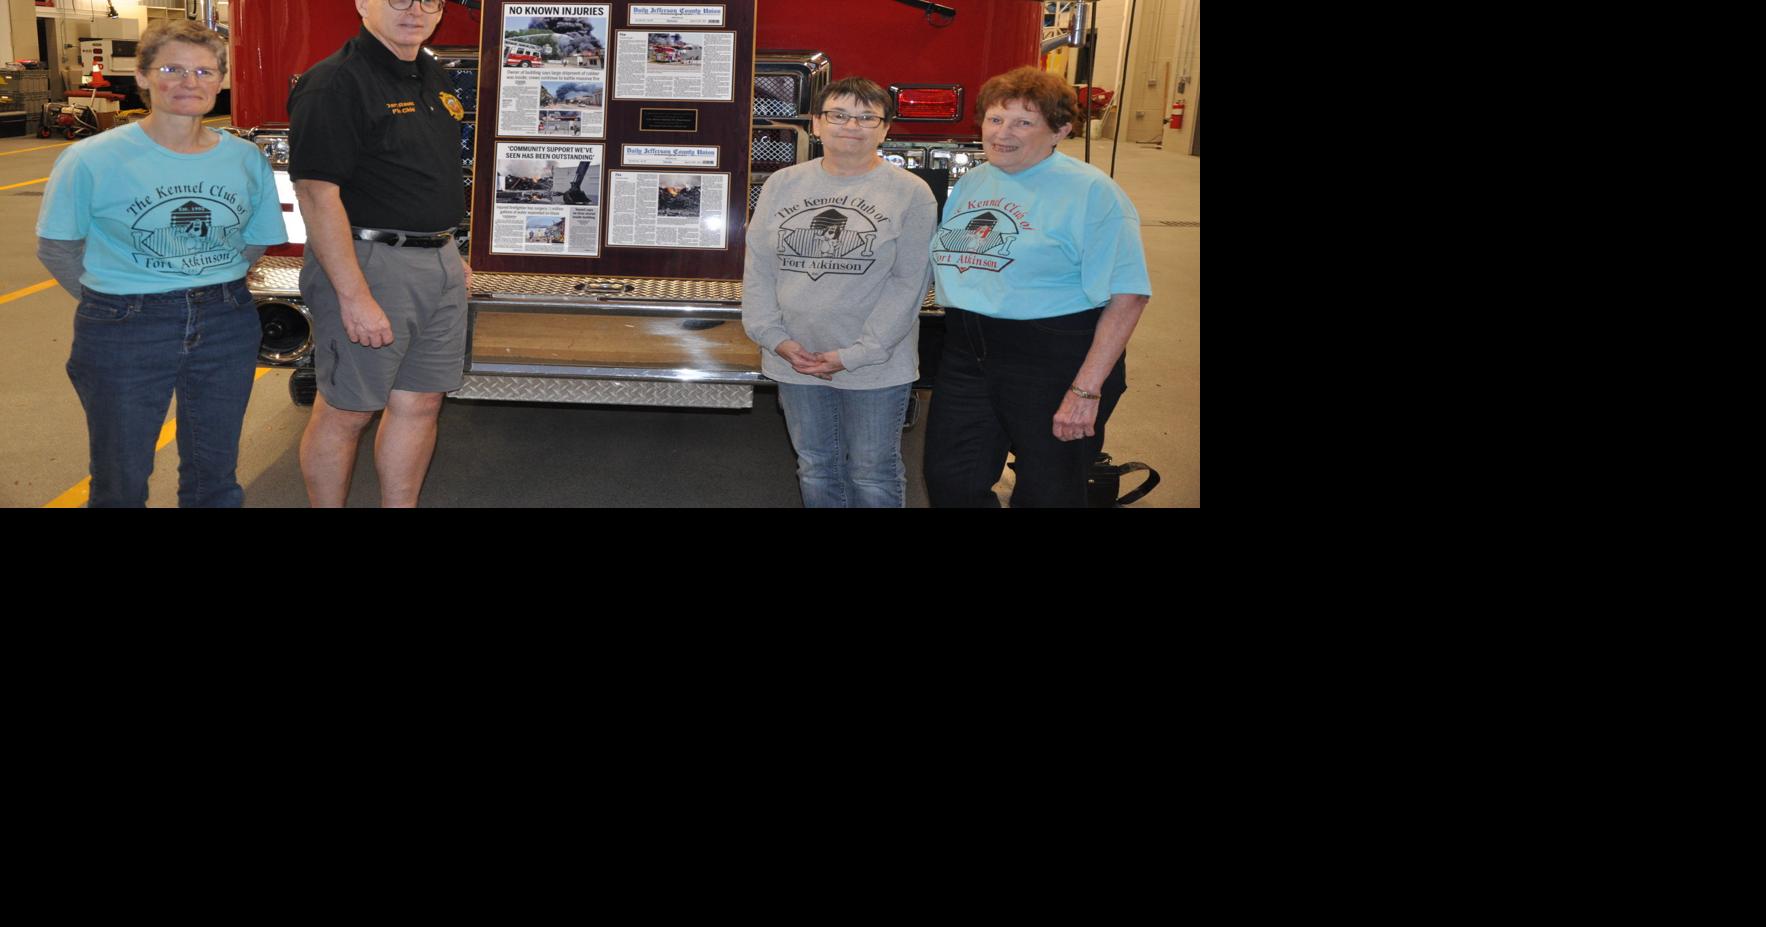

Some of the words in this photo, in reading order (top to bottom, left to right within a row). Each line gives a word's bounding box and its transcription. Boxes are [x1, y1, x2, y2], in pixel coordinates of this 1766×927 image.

[509, 6, 523, 15] NO
[525, 6, 560, 15] KNOWN
[562, 7, 604, 16] INJURIES
[679, 7, 701, 15] County
[626, 147, 642, 155] Daily
[673, 148, 695, 156] County
[127, 194, 153, 216] The
[155, 181, 204, 199] Kennel
[209, 184, 238, 204] Club
[236, 204, 247, 215] of
[774, 203, 800, 219] The
[803, 195, 848, 208] Kennel
[850, 197, 876, 214] Club
[875, 213, 891, 223] of
[145, 257, 173, 269] Fort
[181, 253, 231, 269] Atkinson
[782, 257, 805, 269] Fort
[808, 257, 862, 271] Atkinson
[957, 254, 997, 268] Atkinson
